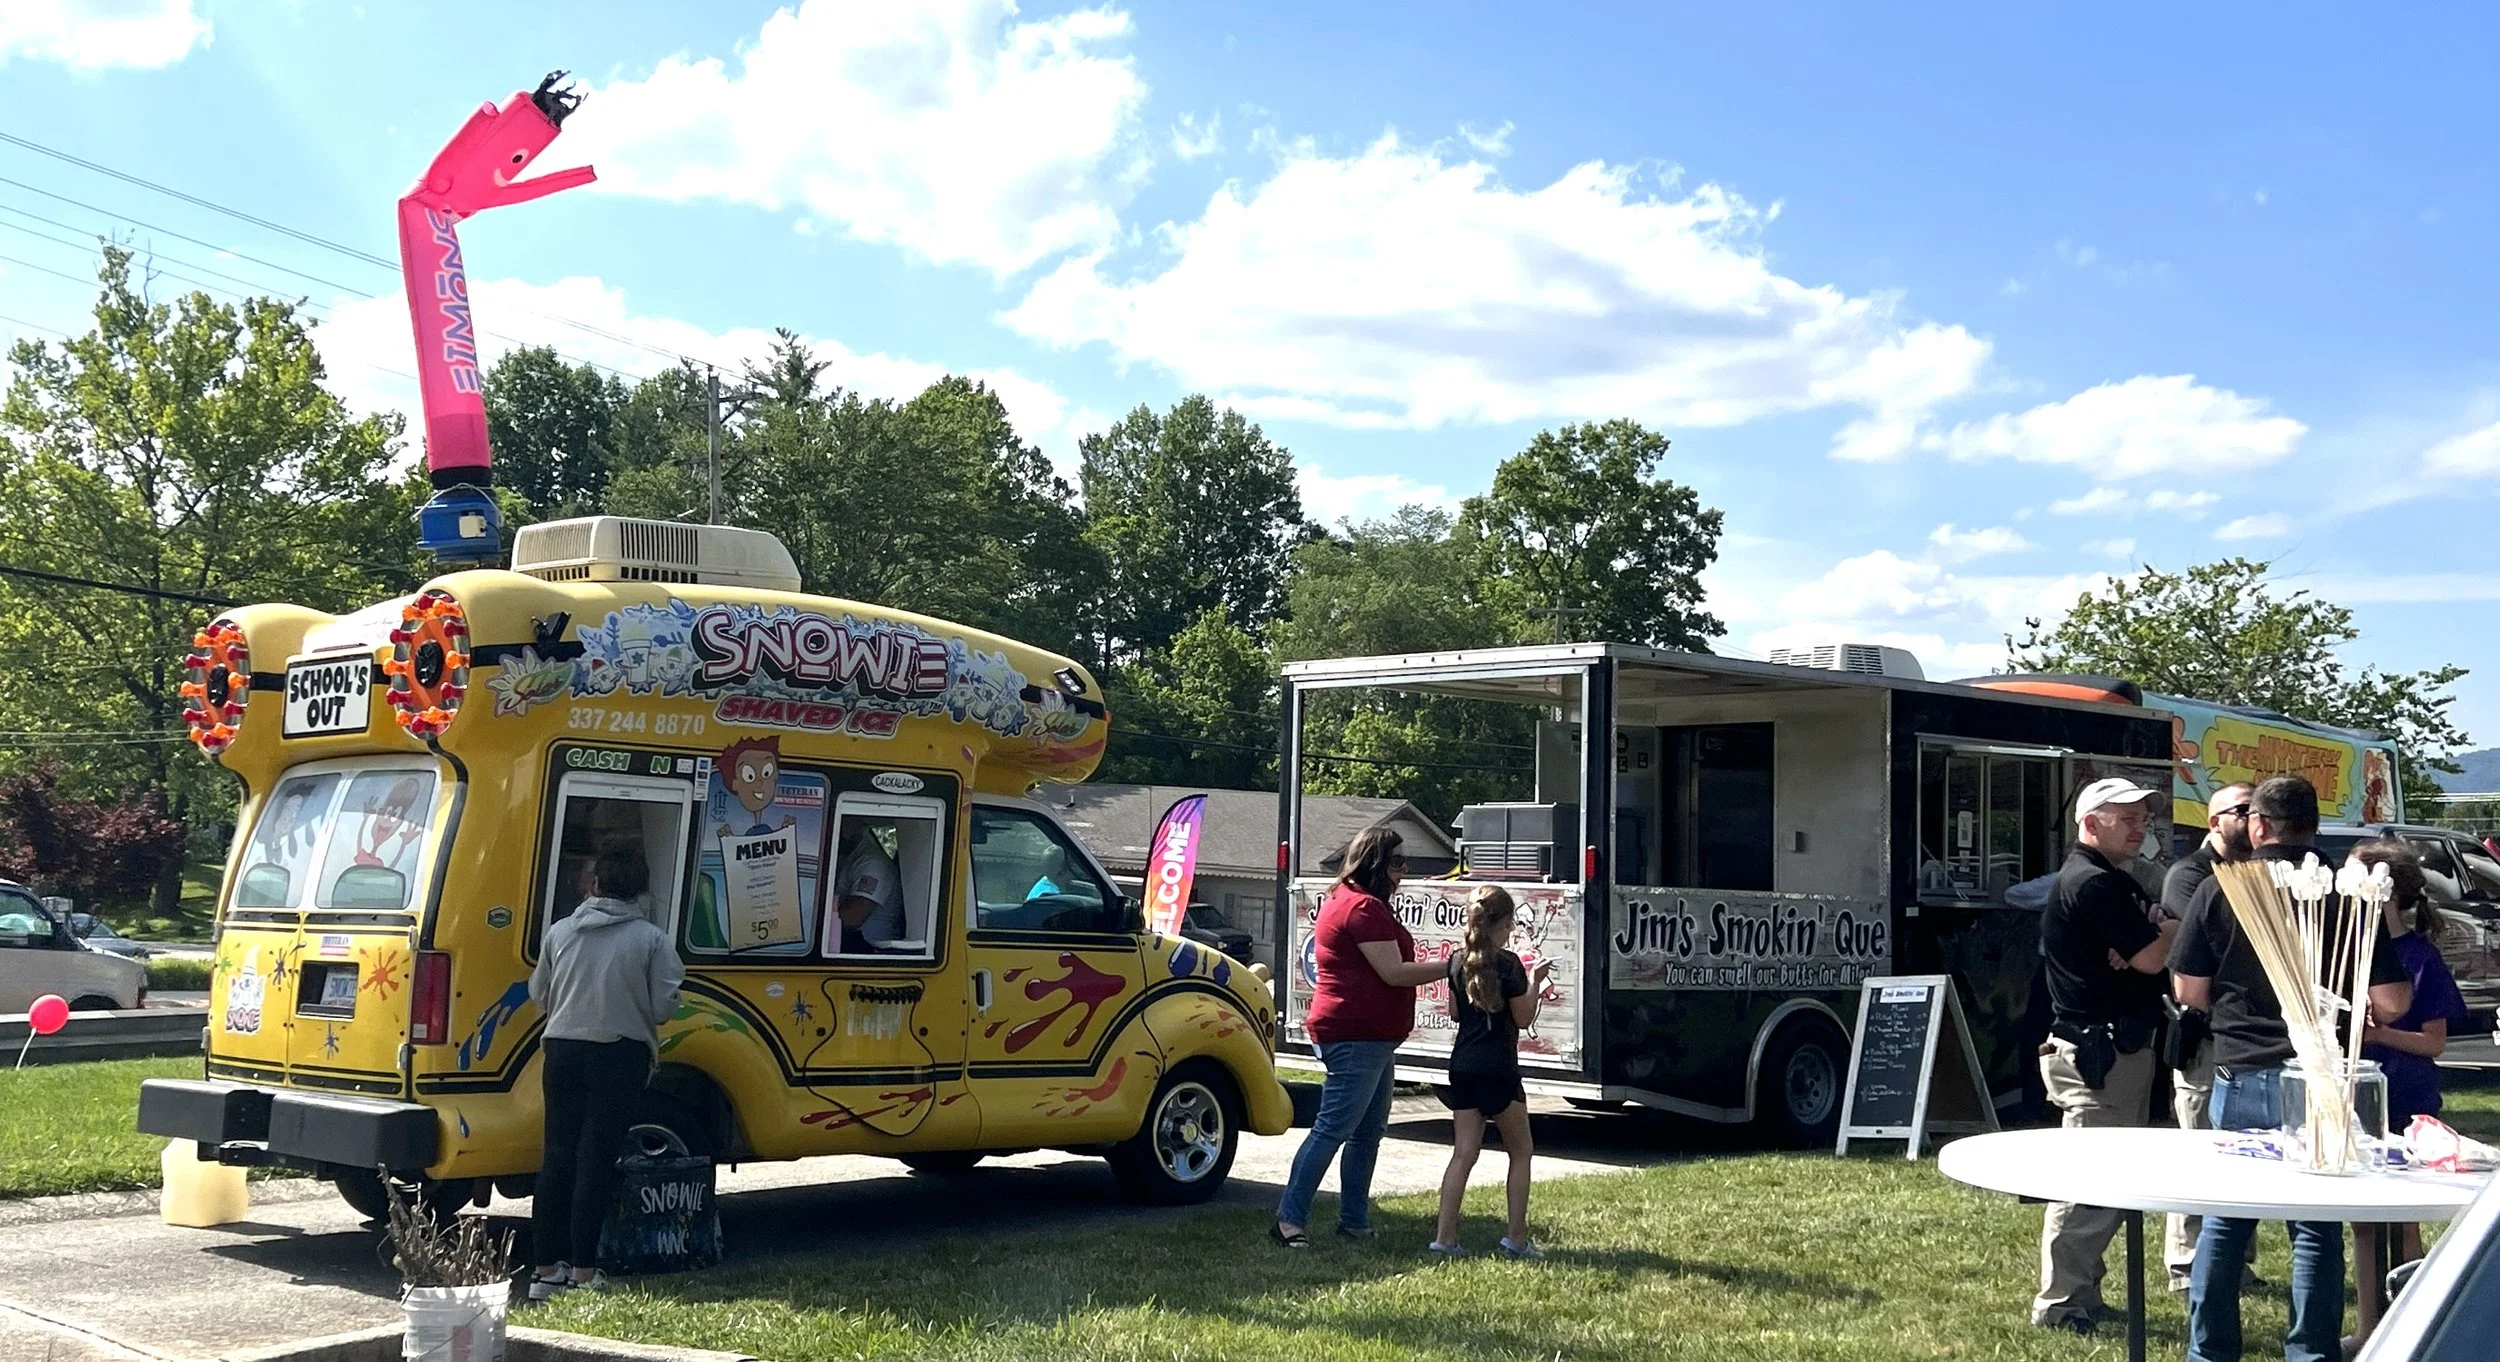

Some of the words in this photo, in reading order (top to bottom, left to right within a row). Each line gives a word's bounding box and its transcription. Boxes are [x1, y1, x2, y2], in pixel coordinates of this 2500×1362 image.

[698, 609, 949, 695] SNOWIE
[290, 665, 368, 703] SCHOOL'S
[307, 695, 346, 728] OUT
[568, 707, 605, 730] 337
[609, 710, 647, 733] 244
[654, 713, 706, 736] 8870
[721, 696, 844, 729] SHAVED
[847, 708, 900, 734] ICE
[566, 748, 631, 770] CASH
[650, 755, 672, 773] N
[2216, 741, 2258, 770] THE
[2257, 734, 2342, 772] MYSTERY
[736, 839, 787, 861] MENU
[1151, 821, 1192, 936] ELCOME
[1614, 897, 1697, 961] Jim's
[1708, 902, 1825, 961] Smokin'
[1834, 910, 1887, 961] Que
[1664, 963, 1686, 986] You
[1690, 966, 1714, 986] can
[1719, 962, 1752, 986] smell
[1756, 966, 1777, 986] our
[1780, 963, 1815, 987] Butts
[1818, 963, 1836, 986] for
[640, 1181, 707, 1214] SNOWIE
